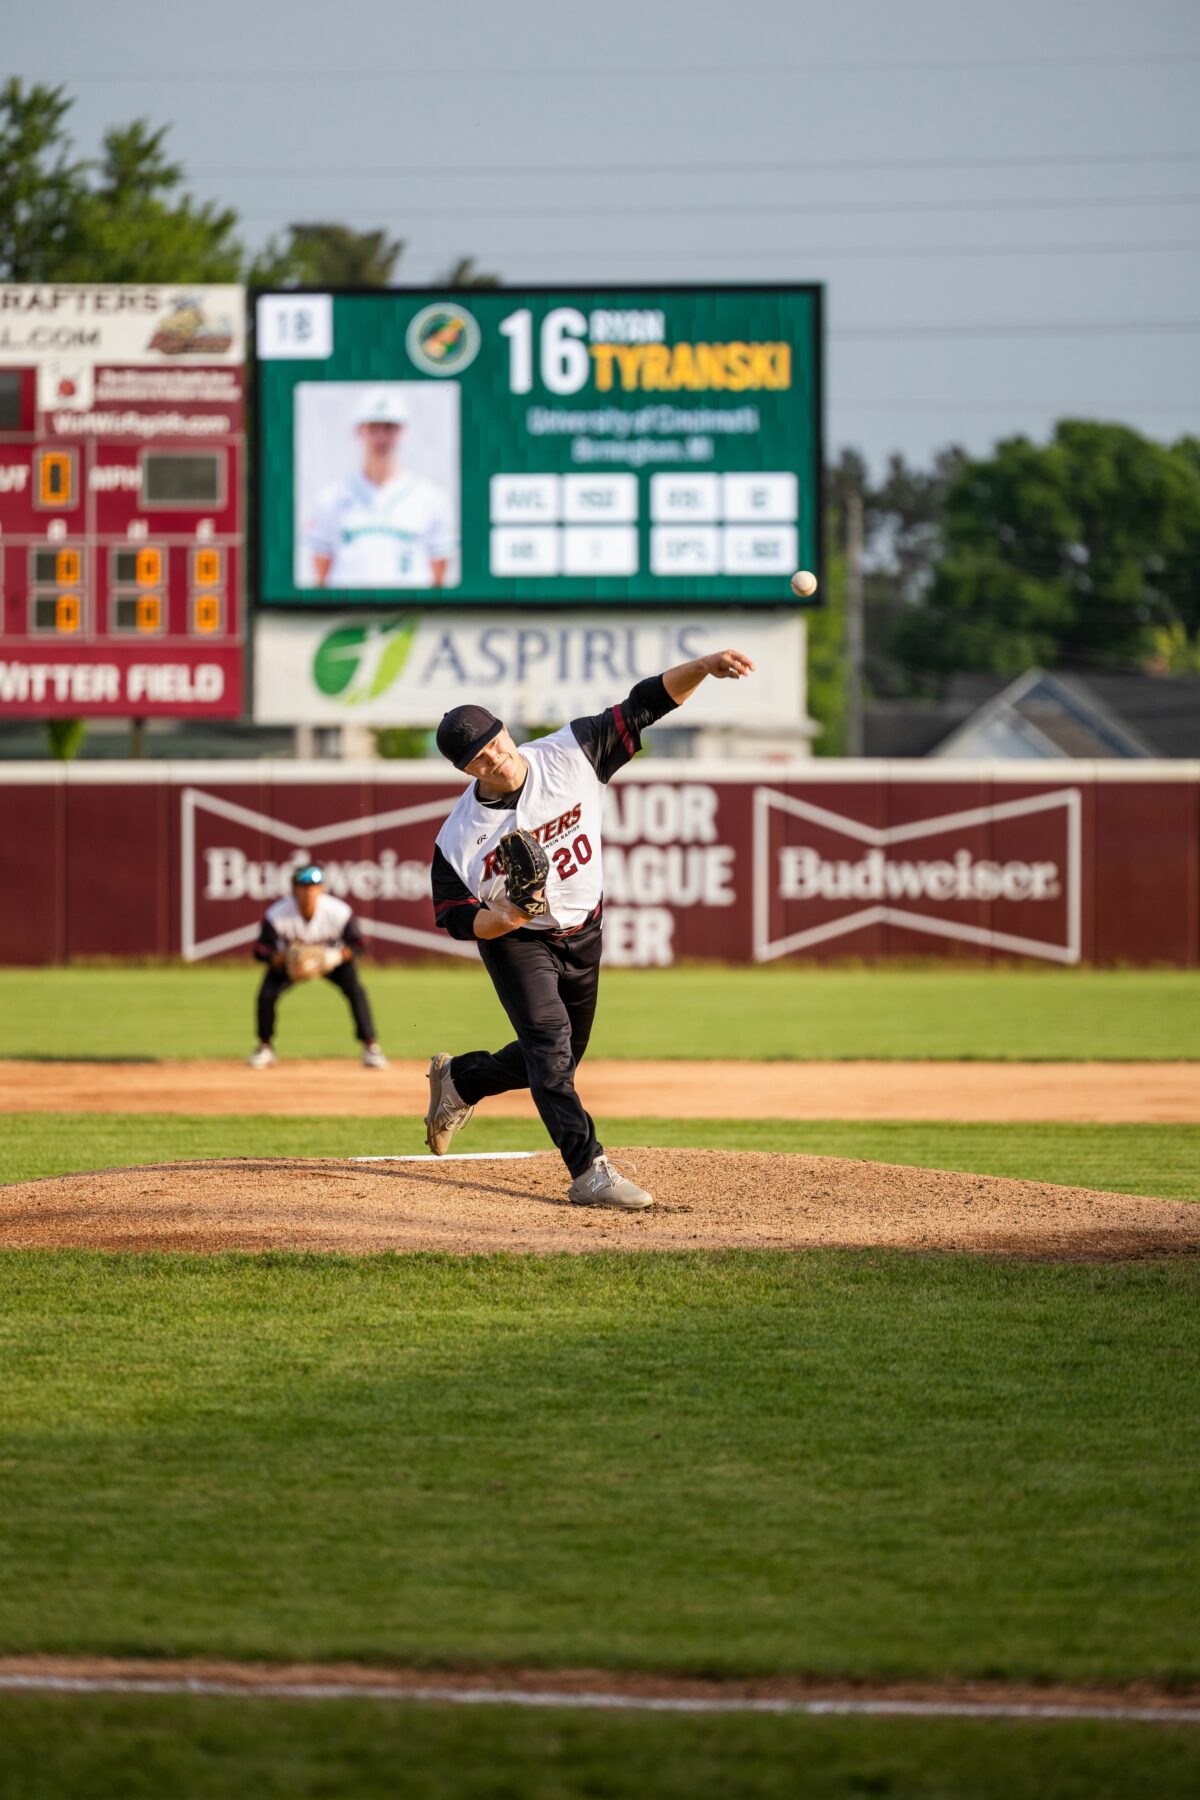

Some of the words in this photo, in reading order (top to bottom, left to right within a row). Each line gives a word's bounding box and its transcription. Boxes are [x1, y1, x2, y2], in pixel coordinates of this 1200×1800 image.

[498, 306, 590, 396] 16
[589, 309, 665, 342] RYAN
[589, 341, 792, 392] TYRANSKI
[526, 406, 632, 437] University
[633, 406, 656, 432] of
[39, 451, 72, 506] 0
[56, 547, 81, 588] 0
[136, 547, 162, 588] 0
[194, 547, 220, 588] 0
[56, 593, 81, 634] 0
[136, 593, 162, 635] 0
[194, 593, 220, 634] 0
[421, 625, 708, 685] ASPIRUS
[127, 665, 225, 703] FIELD
[602, 784, 719, 844] AJOR
[482, 802, 582, 882] RTERS
[552, 833, 593, 882] 20
[603, 845, 737, 907] AGUE
[779, 846, 1058, 901] Budweiser
[603, 907, 676, 968] ER
